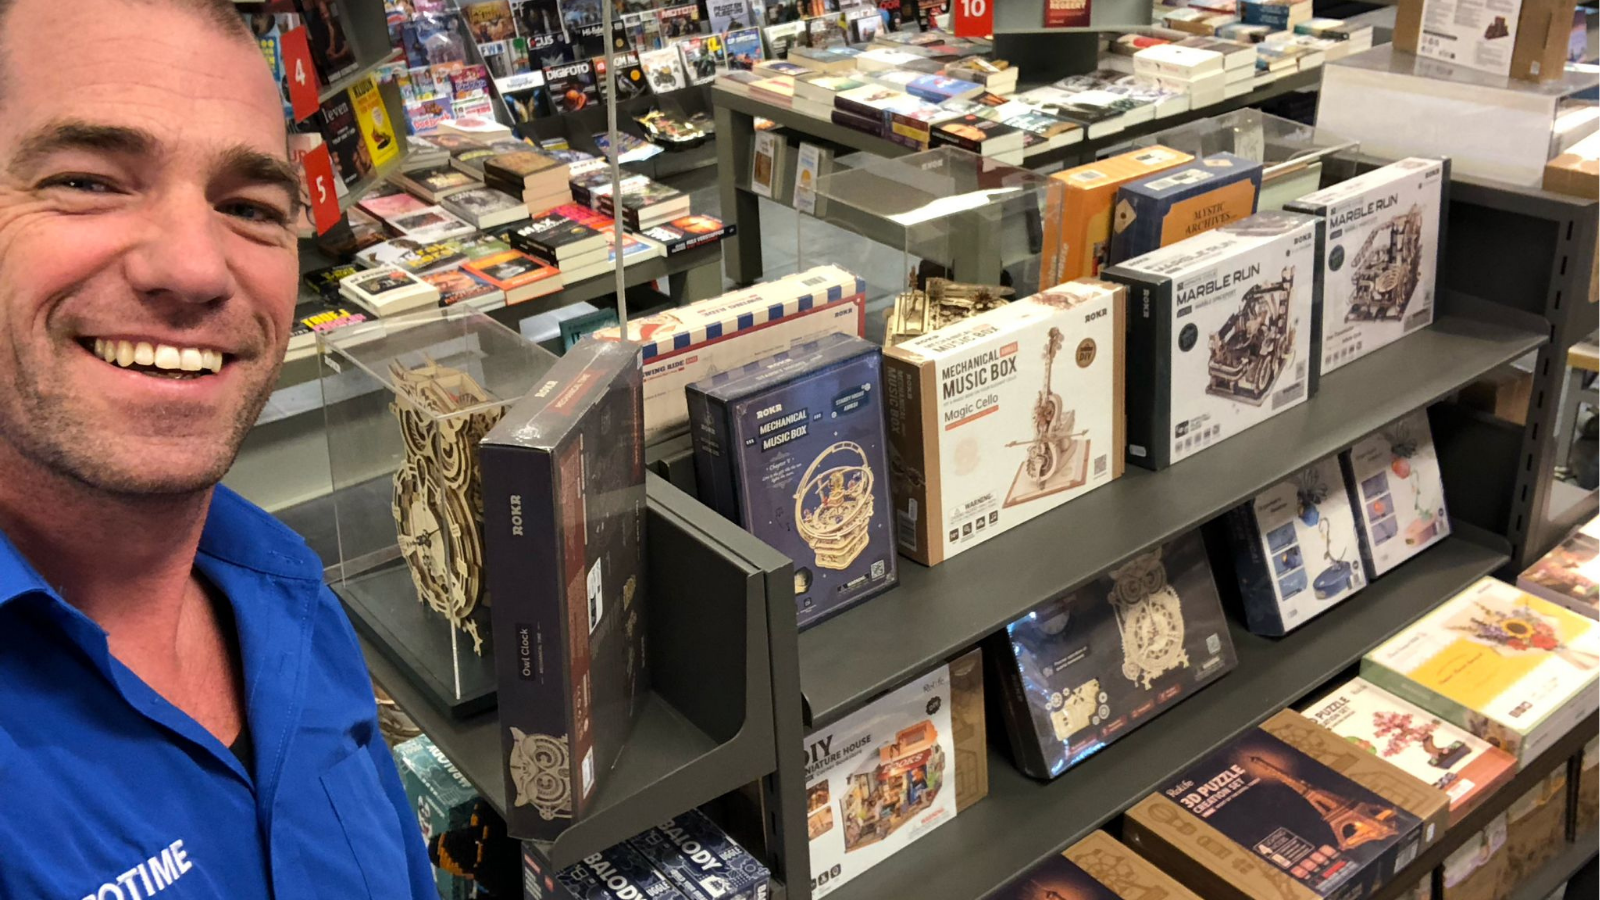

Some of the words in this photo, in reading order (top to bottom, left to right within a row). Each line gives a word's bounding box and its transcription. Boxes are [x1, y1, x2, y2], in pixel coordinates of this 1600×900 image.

[960, 0, 985, 17] 10
[294, 58, 306, 87] 4
[546, 62, 589, 81] DIGIFOTO
[315, 175, 327, 204] 5
[1193, 202, 1225, 221] MYSTIC
[1329, 204, 1375, 229] MARBLE
[1376, 193, 1398, 211] RUN
[1177, 275, 1231, 307] MARBLE
[1233, 263, 1260, 285] RUN
[1084, 307, 1108, 324] ROKR
[667, 359, 684, 371] RIDE
[942, 349, 999, 381] MECHANICAL
[1079, 348, 1094, 363] DIY
[887, 366, 899, 407] MUSIC
[943, 367, 988, 400] MUSIC
[991, 356, 1017, 381] BOX
[757, 404, 782, 419] ROKR
[760, 410, 807, 435] MECHANICAL
[890, 409, 901, 435] BOX
[945, 402, 974, 423] Magic
[975, 393, 999, 414] Cello
[763, 432, 789, 450] MUSIC
[790, 425, 807, 442] BOX
[510, 494, 523, 536] ROKR
[520, 628, 530, 656] Clock
[521, 656, 532, 677] Owl
[1315, 696, 1351, 720] PUZZLE
[804, 750, 841, 775] NIATURE
[843, 735, 871, 754] HOUSE
[1180, 793, 1202, 809] 3D
[1197, 764, 1246, 797] PUZZLE
[1193, 786, 1232, 814] CREATION
[1228, 778, 1245, 791] SET
[660, 819, 723, 871] BALODY
[81, 839, 193, 900] OTIME
